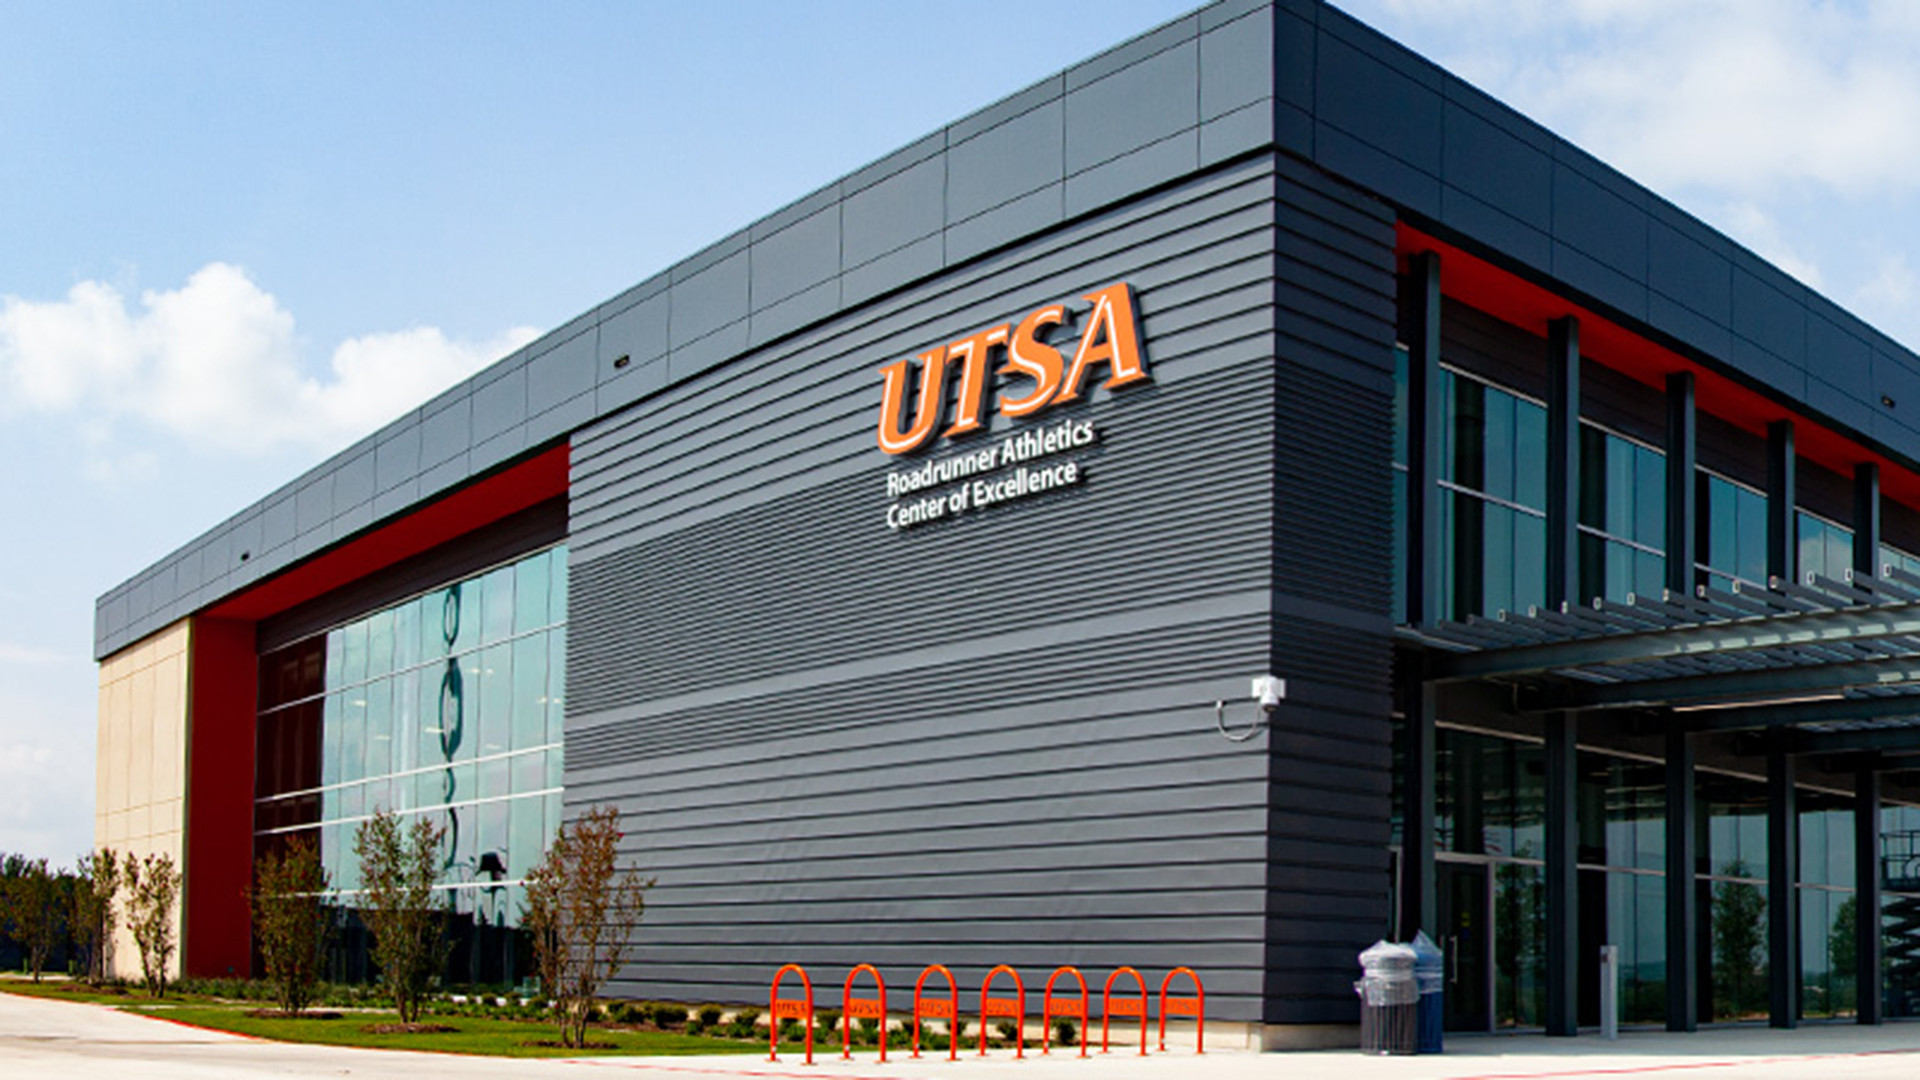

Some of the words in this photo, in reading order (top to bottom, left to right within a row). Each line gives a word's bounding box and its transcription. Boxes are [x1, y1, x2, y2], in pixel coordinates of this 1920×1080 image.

[877, 281, 1147, 455] UTSA
[887, 447, 998, 497] Roadrunner
[1001, 419, 1093, 465] Athletics
[887, 495, 946, 529] Center
[950, 482, 970, 512] of
[973, 462, 1077, 507] Excellence
